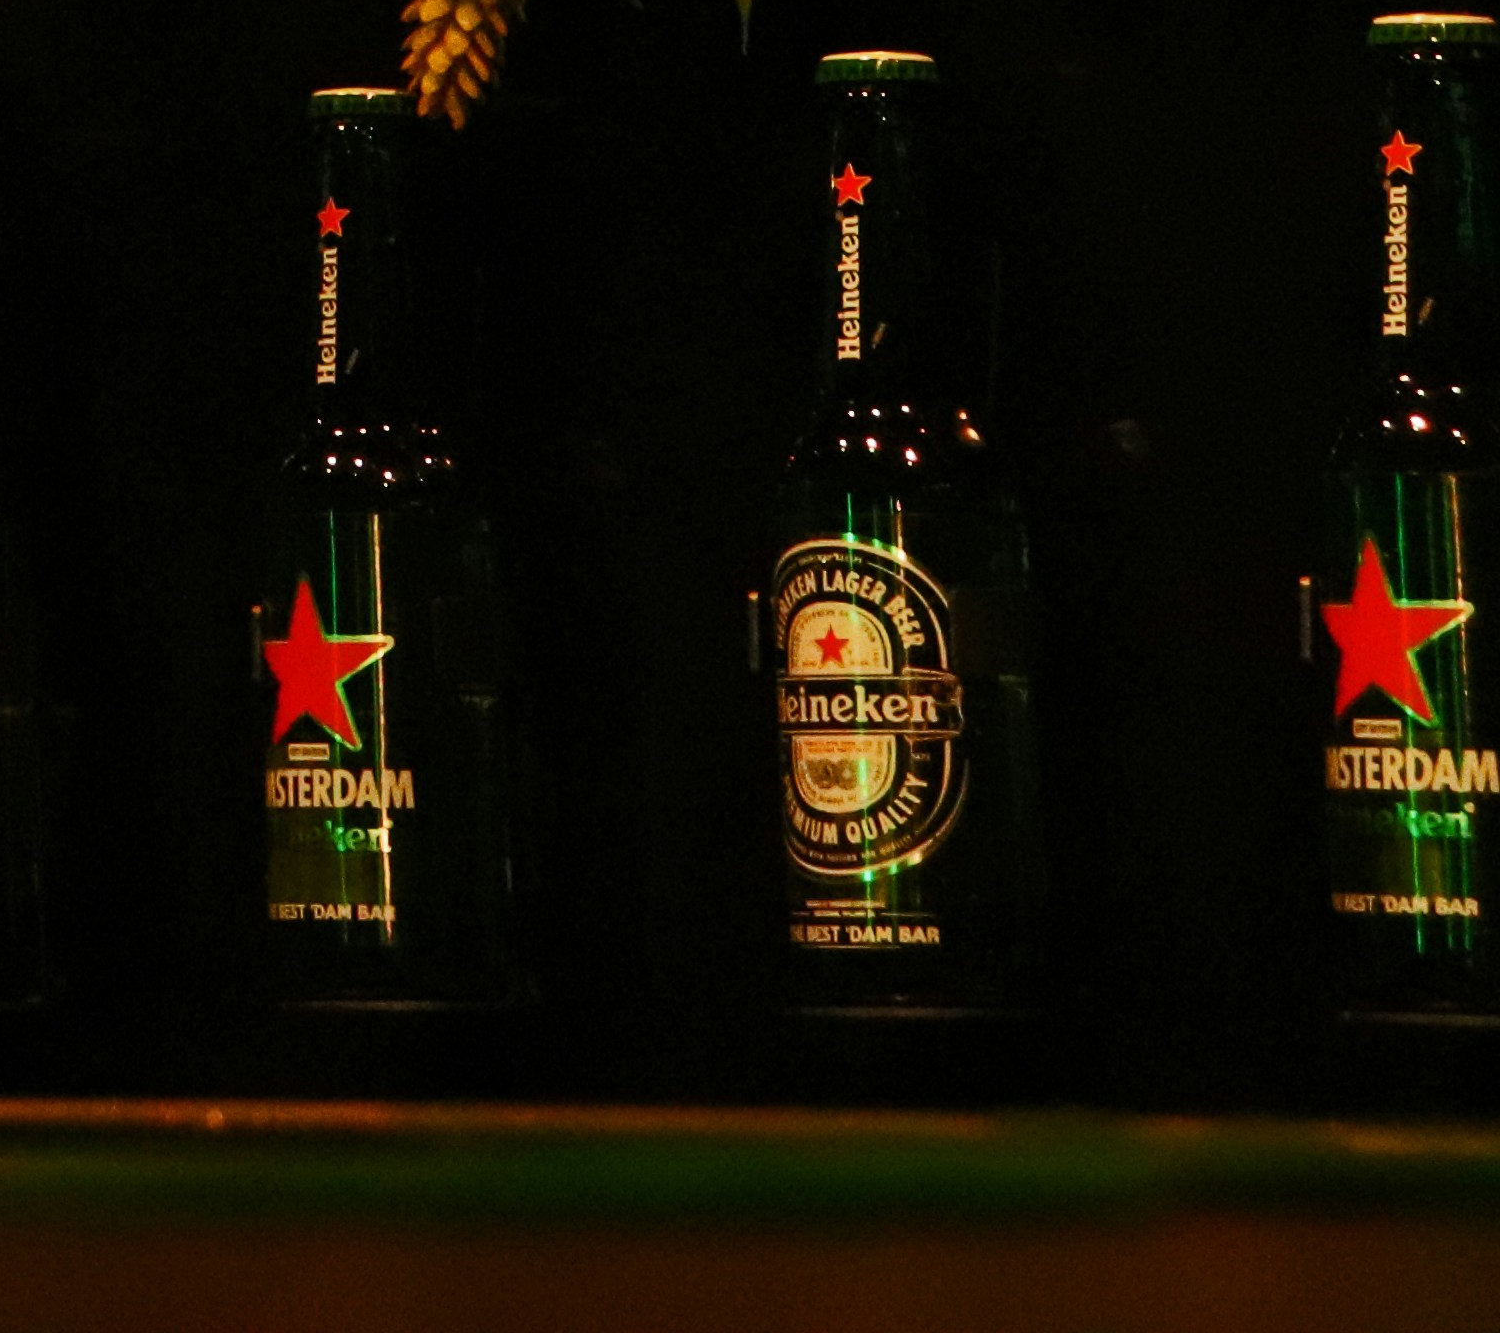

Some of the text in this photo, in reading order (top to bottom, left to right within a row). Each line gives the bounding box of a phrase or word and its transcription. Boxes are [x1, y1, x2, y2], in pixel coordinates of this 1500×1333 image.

[837, 216, 861, 361] Heineken
[1383, 185, 1408, 337] Heineken
[317, 248, 338, 385] Heineken
[822, 569, 887, 605] LAGER
[883, 595, 925, 649] BEER
[845, 771, 928, 844] QUALITY
[898, 925, 940, 944] BAR
